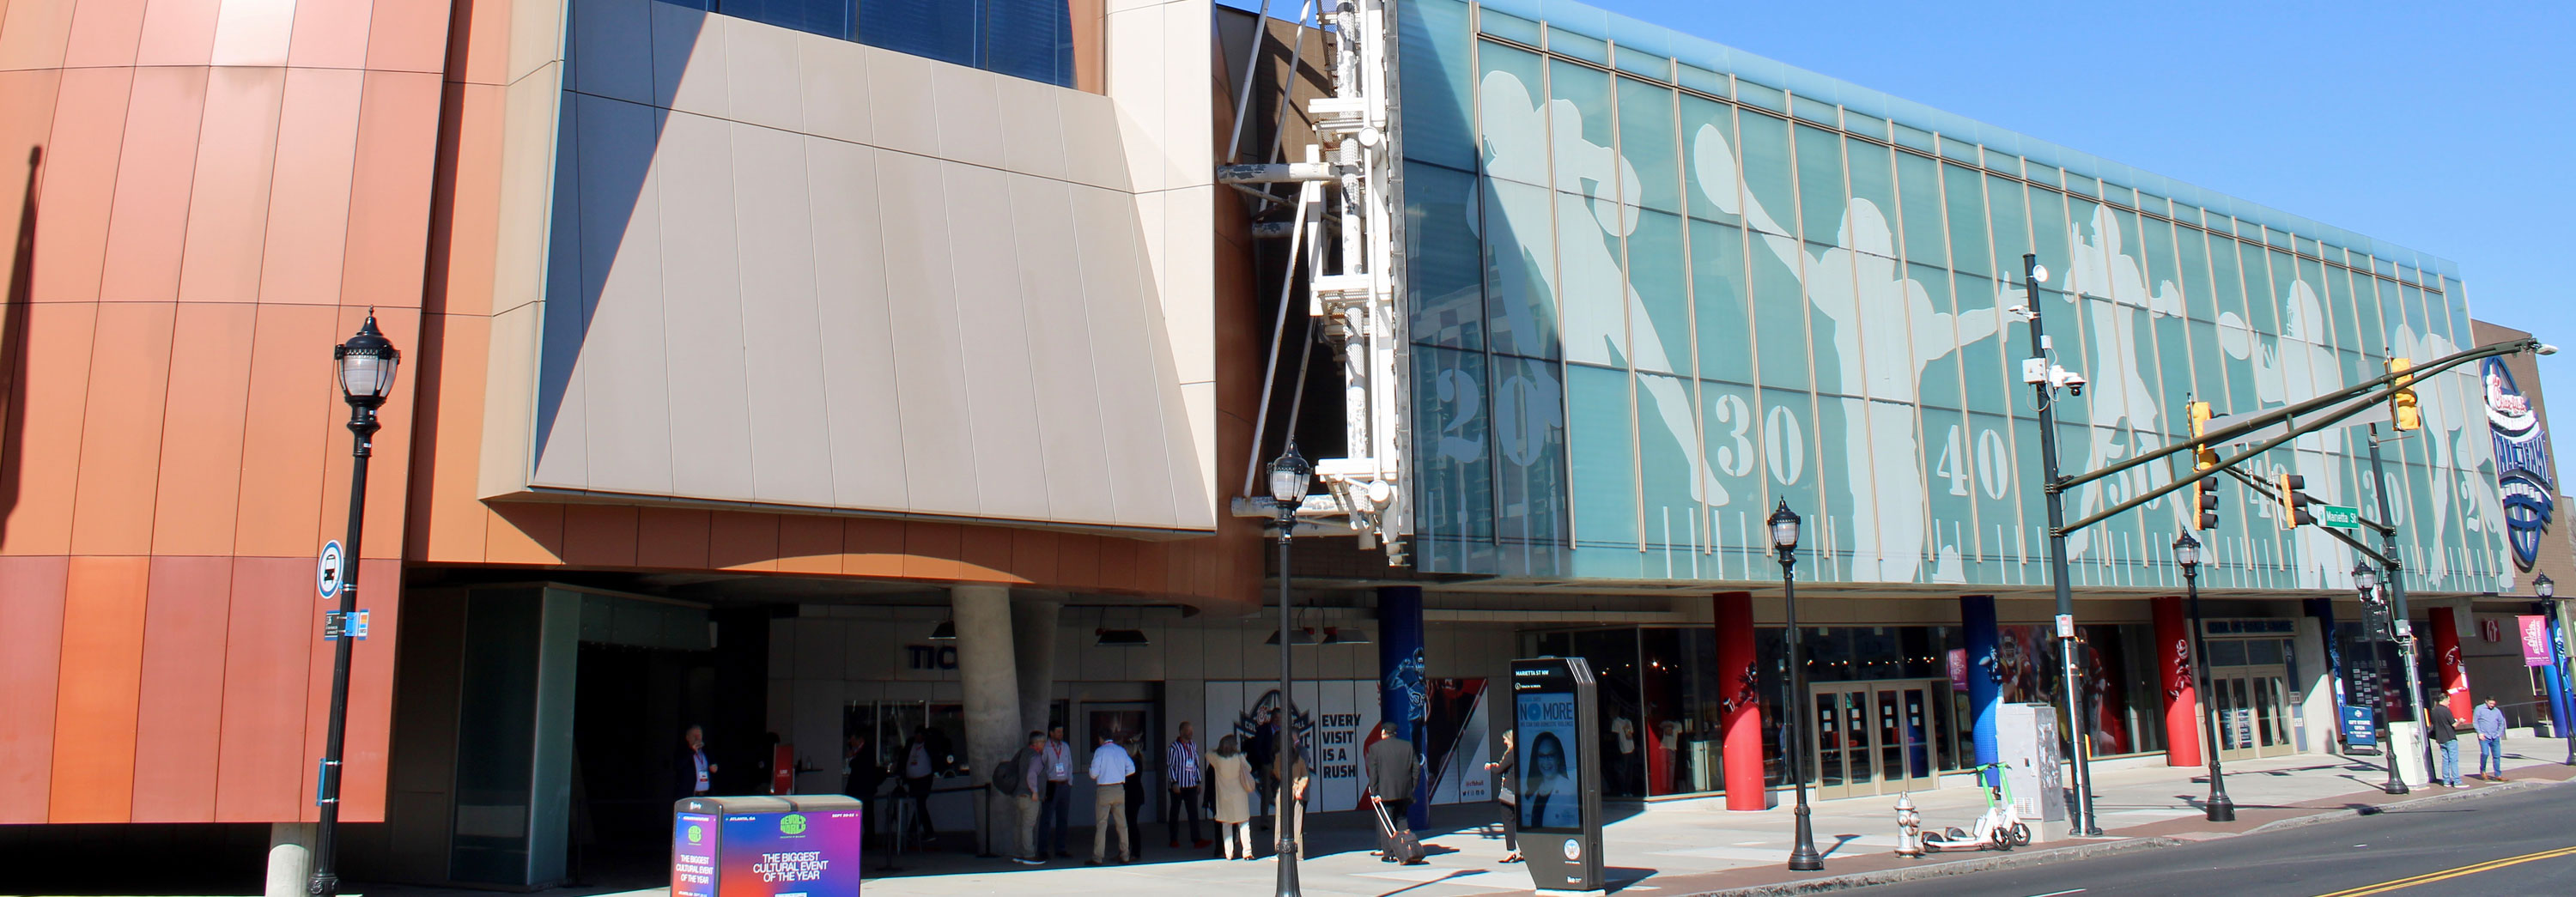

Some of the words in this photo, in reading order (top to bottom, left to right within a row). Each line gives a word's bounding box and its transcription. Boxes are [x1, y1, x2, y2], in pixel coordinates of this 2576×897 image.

[1716, 394, 1804, 486] 30
[1937, 424, 2008, 500] 40
[2326, 511, 2348, 523] Marietta
[2350, 512, 2357, 524] St
[1520, 703, 1541, 721] NO
[1543, 702, 1573, 721] MORE
[1321, 714, 1361, 727] EVERY
[1322, 730, 1353, 744] VISIT
[1322, 749, 1334, 761] IS
[1338, 748, 1346, 761] A
[1323, 765, 1356, 779] RUSH
[681, 854, 690, 863] THE
[690, 855, 710, 864] BIGGEST
[762, 853, 781, 864] THE
[781, 852, 820, 862] BIGGEST
[676, 864, 699, 873] CULTURAL
[699, 865, 714, 875] EVENT
[753, 862, 799, 874] CULTURAL
[800, 860, 829, 870] EVENT
[681, 873, 688, 882] OF
[697, 875, 709, 884] YEAR
[763, 872, 775, 882] OF
[777, 871, 795, 882] THE
[797, 870, 820, 881] YEAR
